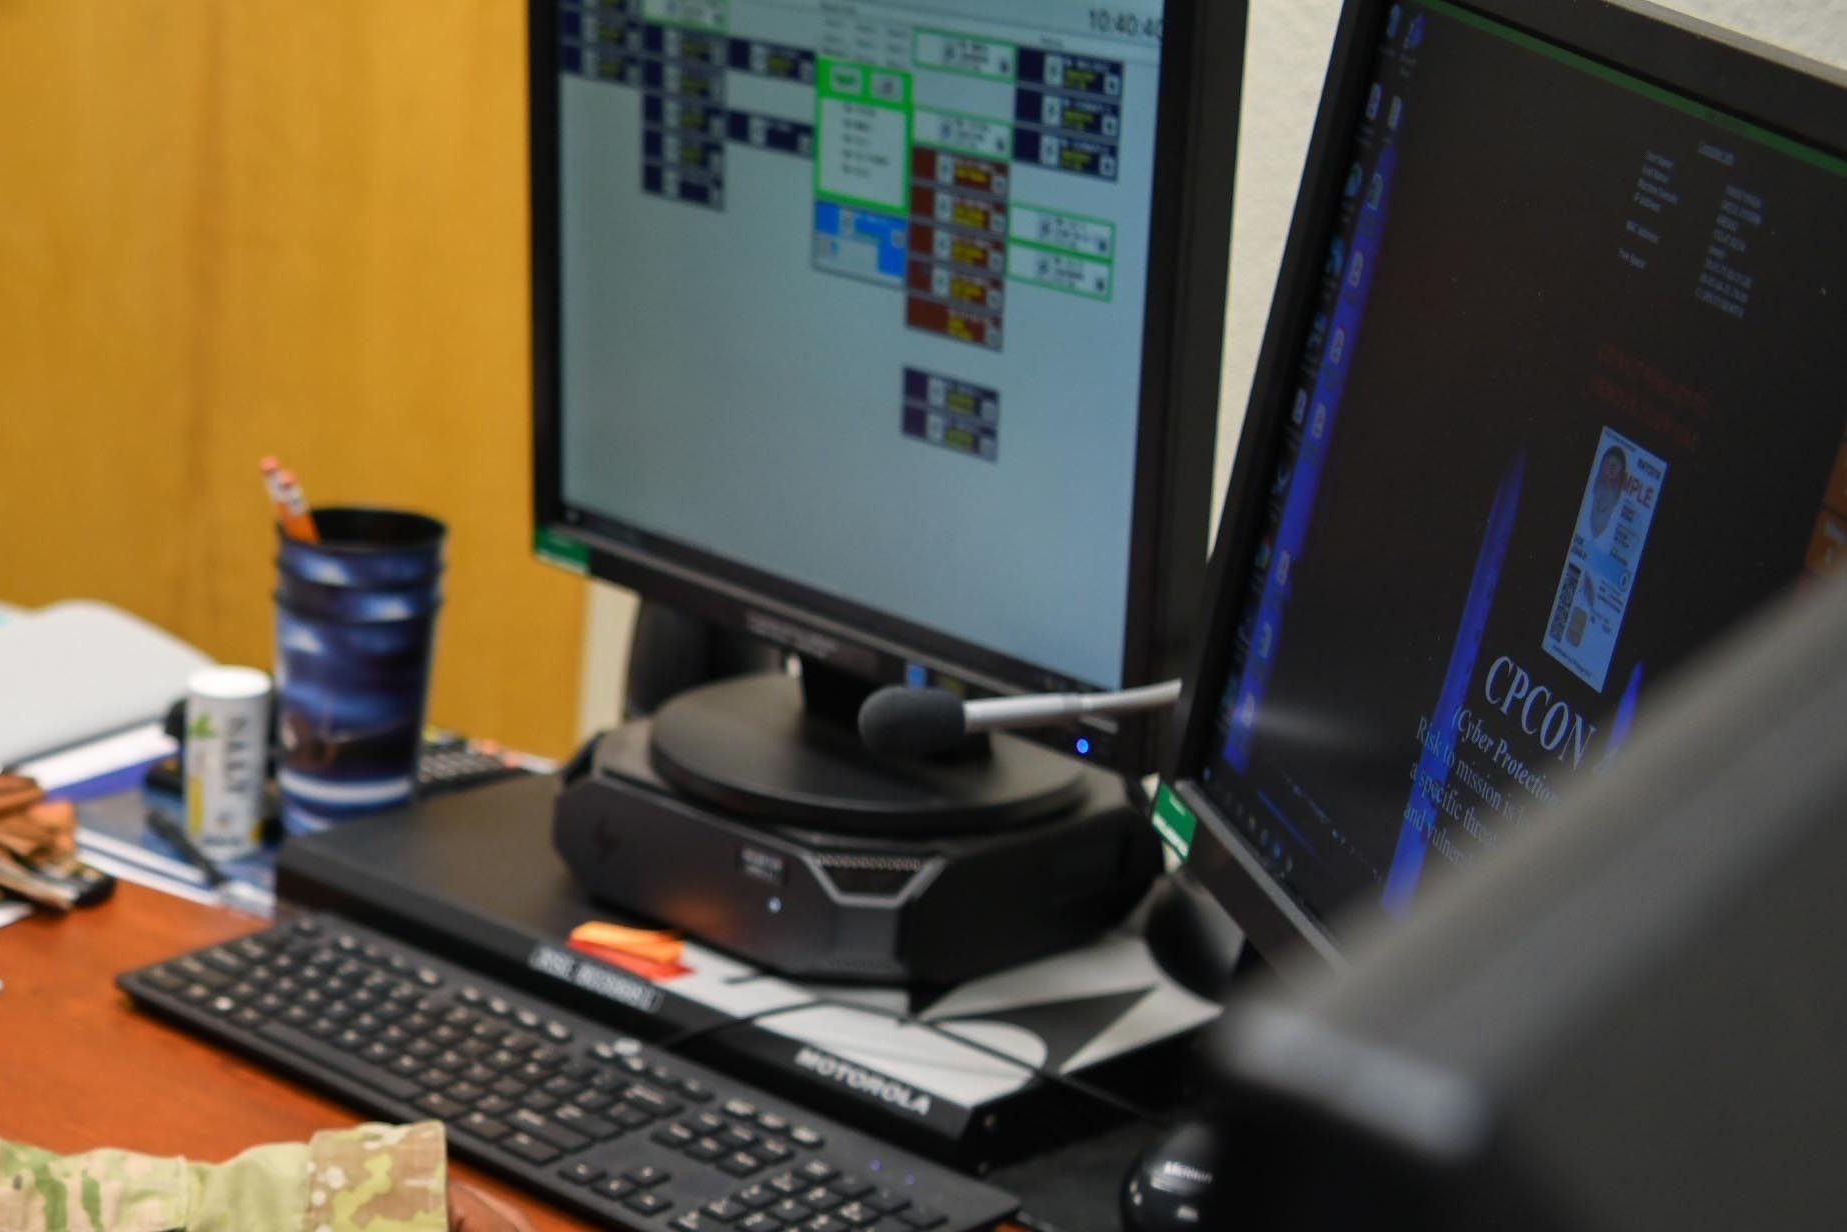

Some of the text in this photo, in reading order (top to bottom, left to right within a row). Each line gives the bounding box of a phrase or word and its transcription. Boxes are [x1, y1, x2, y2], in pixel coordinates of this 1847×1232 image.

[1485, 656, 1597, 770] CPCON
[1417, 717, 1440, 756] Risk
[1444, 744, 1456, 768] to
[1457, 760, 1502, 811] mission
[1419, 769, 1461, 820] specific
[1404, 805, 1423, 831] and
[795, 1047, 931, 1117] MOTOROLA
